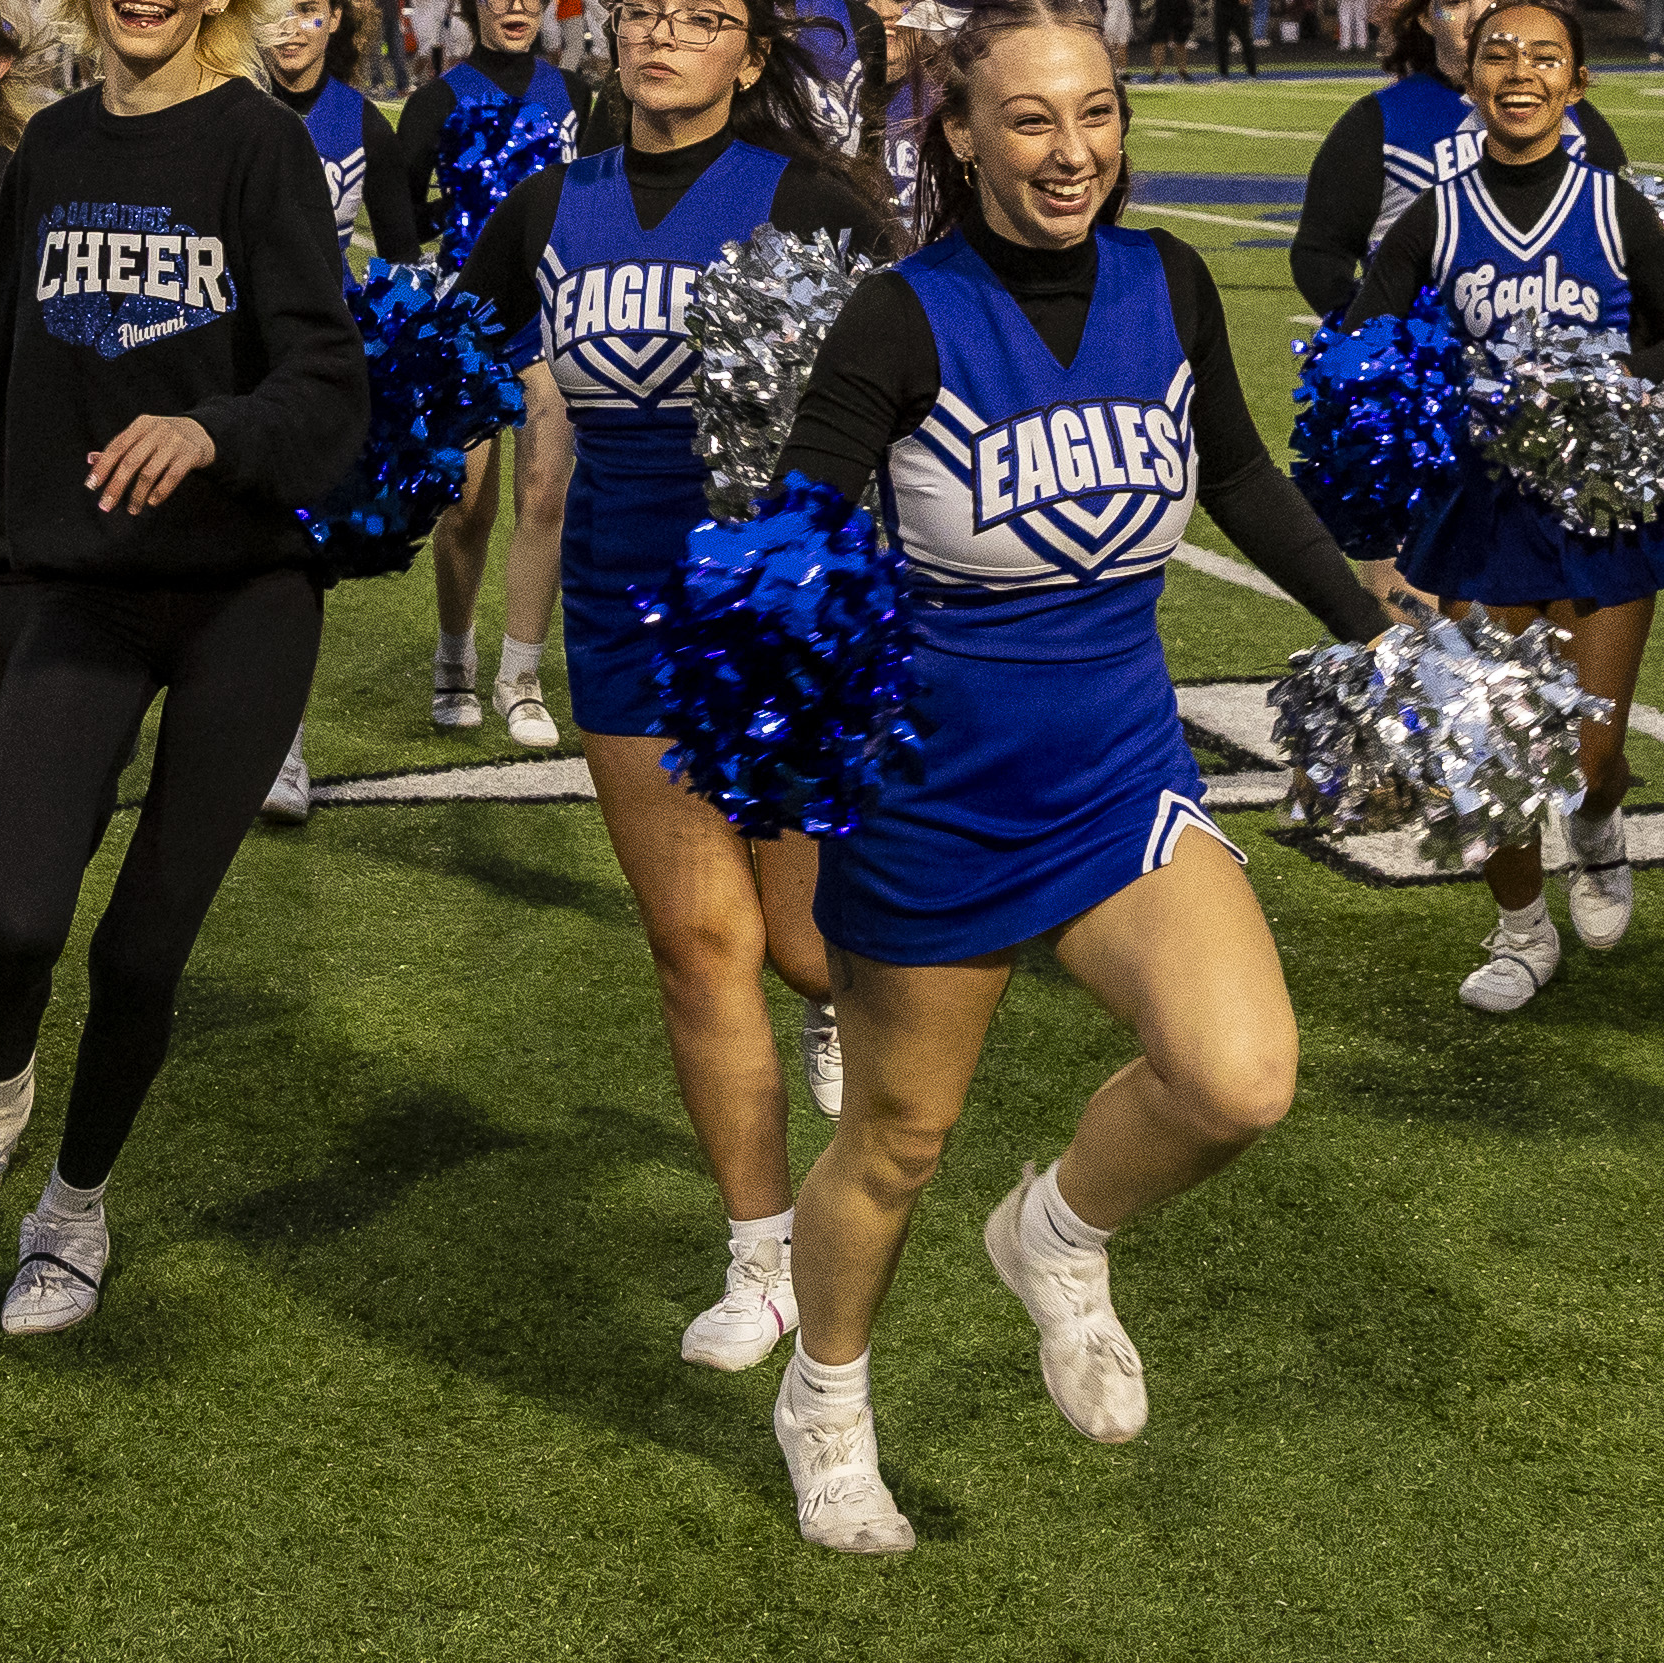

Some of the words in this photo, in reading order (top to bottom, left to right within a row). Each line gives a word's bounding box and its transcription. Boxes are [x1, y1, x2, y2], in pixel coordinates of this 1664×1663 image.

[37, 230, 226, 313] CHEER
[554, 264, 698, 350] EAGLE
[1454, 255, 1600, 338] Eagles
[117, 309, 188, 349] Alumni
[978, 406, 1185, 522] EAGLES
